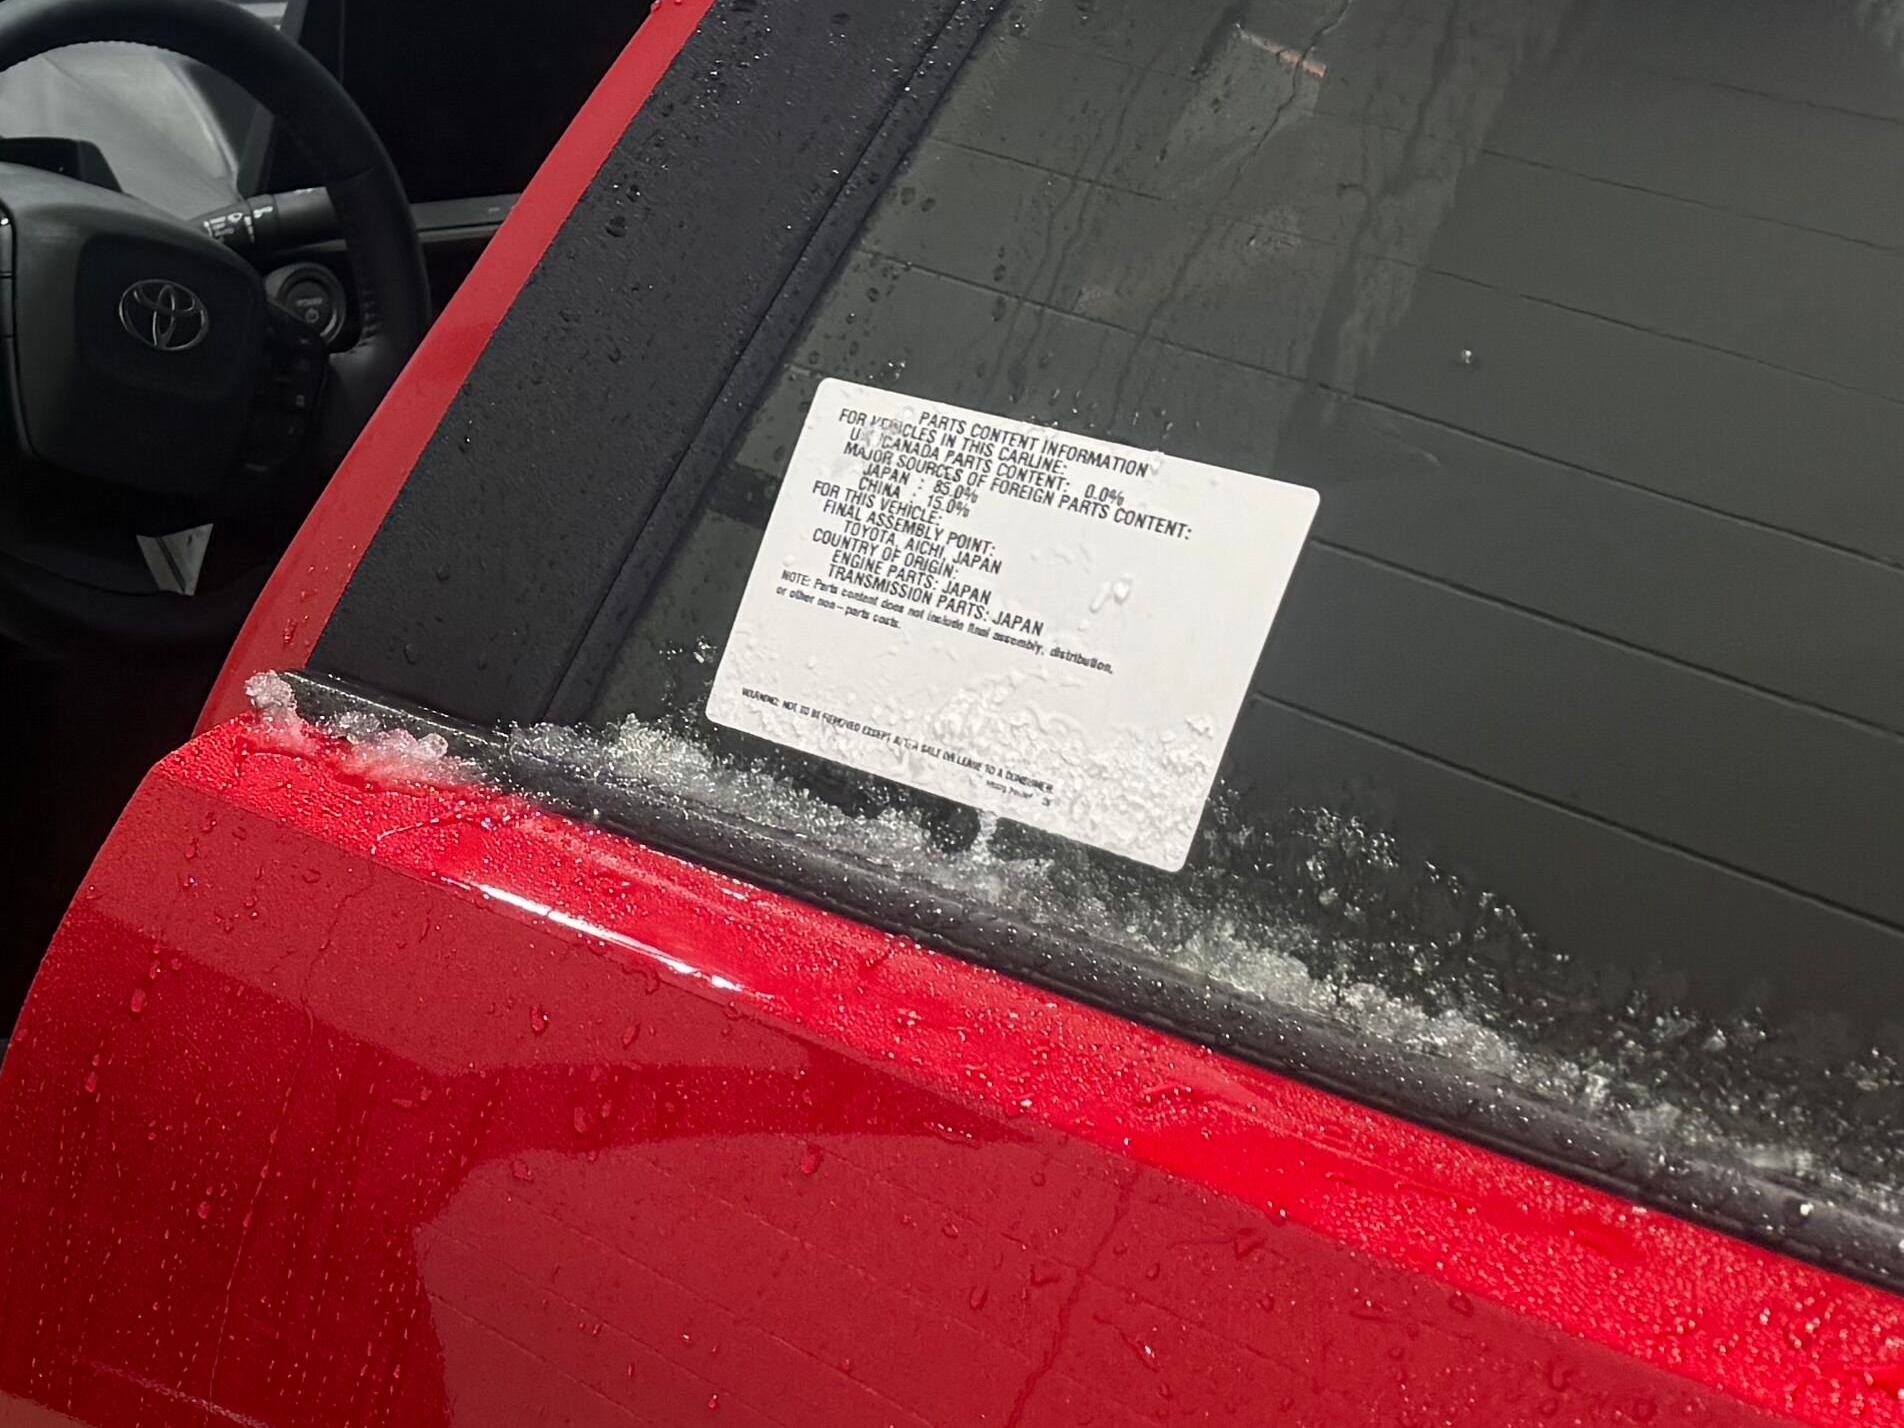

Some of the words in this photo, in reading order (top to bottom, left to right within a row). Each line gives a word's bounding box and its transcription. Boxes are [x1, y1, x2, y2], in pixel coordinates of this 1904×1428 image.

[837, 407, 868, 427] FOR
[939, 431, 958, 448] IN
[960, 436, 996, 457] THIS
[996, 444, 1069, 475] CARLINE:
[917, 410, 968, 435] PARTS
[968, 422, 1040, 452] CONTENT
[1039, 439, 1150, 478] INFORMATION
[811, 479, 841, 500] FOR
[842, 487, 877, 509] THIS
[877, 496, 944, 526] VEHICLE:
[842, 441, 894, 466] MAJOR
[895, 454, 964, 483] SOURCES
[965, 471, 988, 489] OF
[989, 476, 1056, 505] FOREIGN
[1057, 493, 1111, 519] PARTS
[1112, 506, 1193, 540] CONTENT:
[856, 475, 903, 500] CHINA
[924, 492, 972, 518] 15.0%
[861, 461, 911, 486] JAPAN
[932, 478, 980, 503] 85.0%
[943, 449, 994, 474] PARTS
[994, 461, 1071, 493] CONTENT:
[1083, 482, 1127, 507] 0.0%
[811, 527, 879, 558] COUNTRY
[880, 545, 902, 564] OF
[902, 551, 960, 580] ORIGIN:
[822, 498, 865, 522] FINAL
[865, 509, 944, 542] ASSEMBLY
[945, 530, 998, 556] POINT:
[840, 519, 902, 548] TOYOTA,
[902, 536, 950, 563] AICHI,
[951, 548, 1003, 575] JAPAN
[775, 585, 787, 596] or
[788, 587, 815, 604] other
[780, 568, 812, 587] NOTE:
[812, 577, 840, 595] Parts
[840, 585, 879, 606] content
[879, 596, 906, 613] does
[907, 604, 925, 619] not
[926, 609, 966, 630] include
[966, 620, 991, 637] final
[825, 563, 934, 605] TRANSMISSION
[935, 593, 991, 621] PARTS:
[991, 608, 1045, 636] JAPAN
[830, 548, 885, 575] ENGINE
[885, 563, 940, 590] PARTS:
[941, 578, 993, 605] JAPAN
